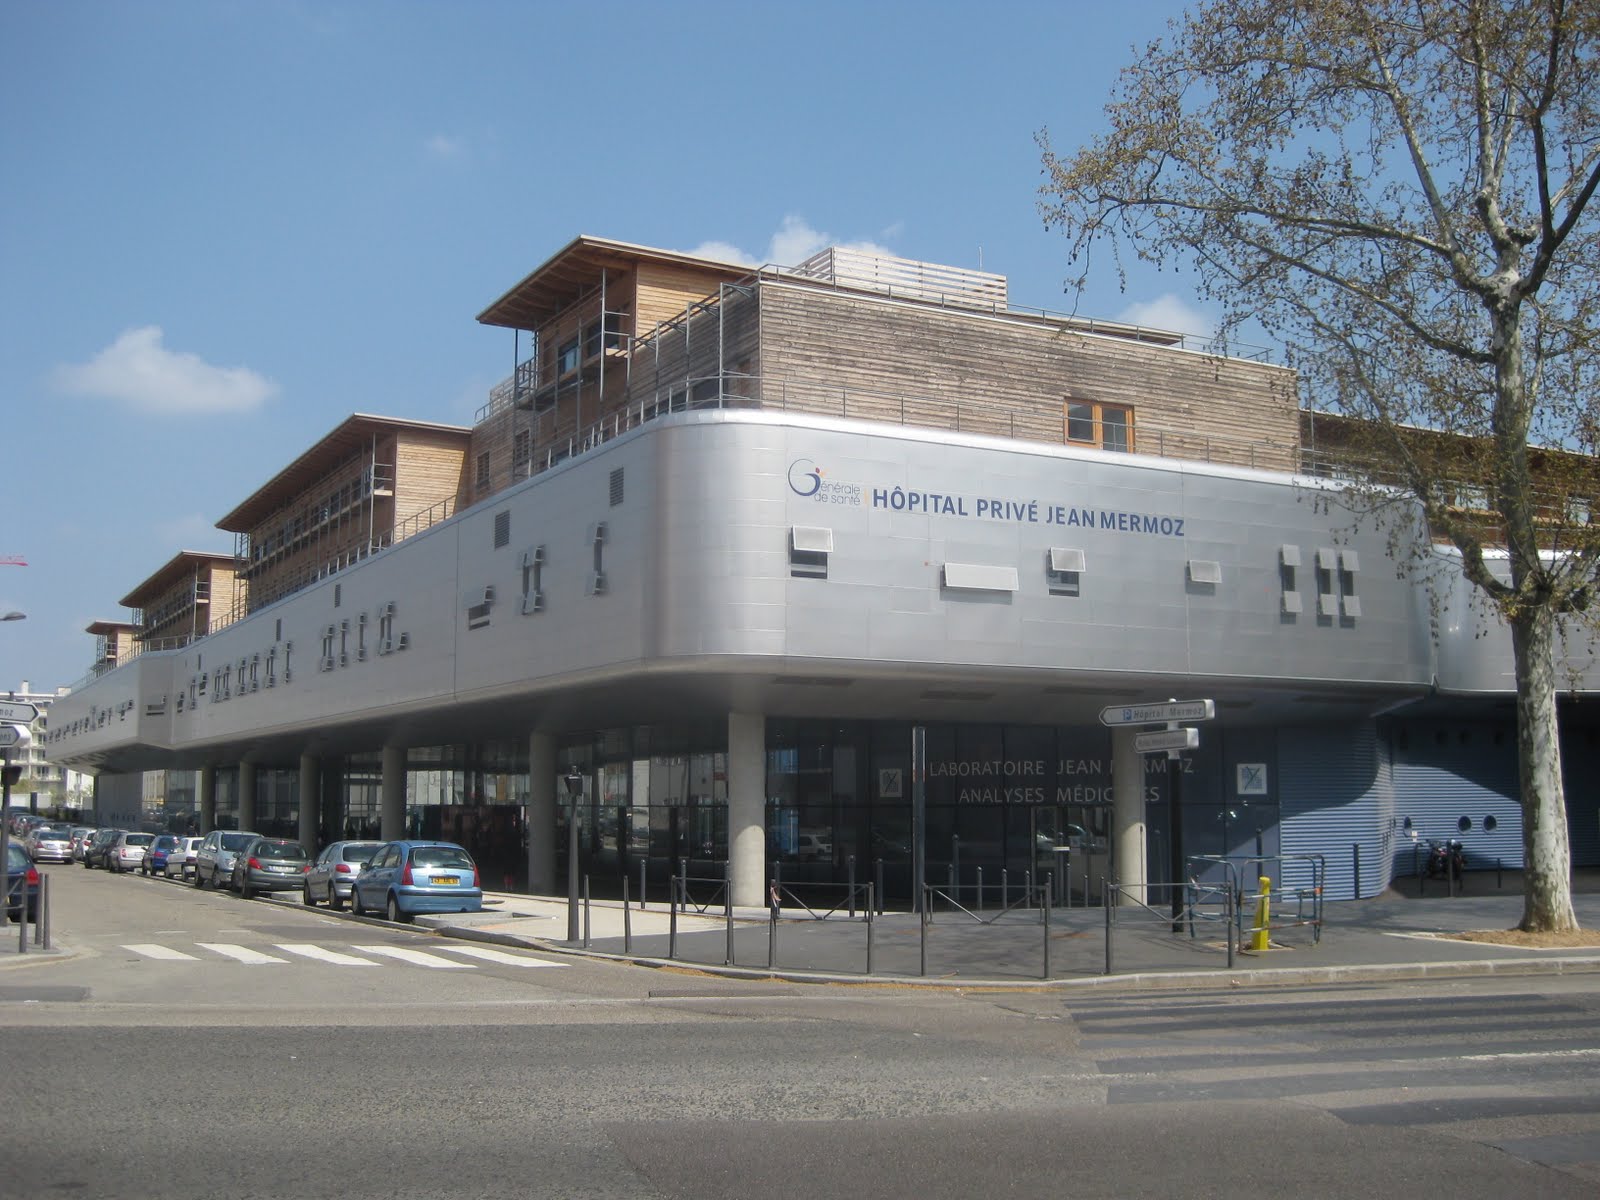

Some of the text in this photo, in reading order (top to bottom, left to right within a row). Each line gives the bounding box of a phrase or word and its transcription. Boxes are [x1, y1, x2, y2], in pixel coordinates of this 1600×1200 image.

[814, 492, 861, 506] de santé
[872, 486, 1185, 537] HÔPITAL PRIVÉ JEAN MERMOZ
[1133, 707, 1164, 721] Hôpital
[1169, 706, 1202, 717] Mermoz
[929, 760, 1045, 777] LABORATOIRE
[1056, 758, 1102, 776] JEAN
[958, 787, 1045, 803] ANALYSES
